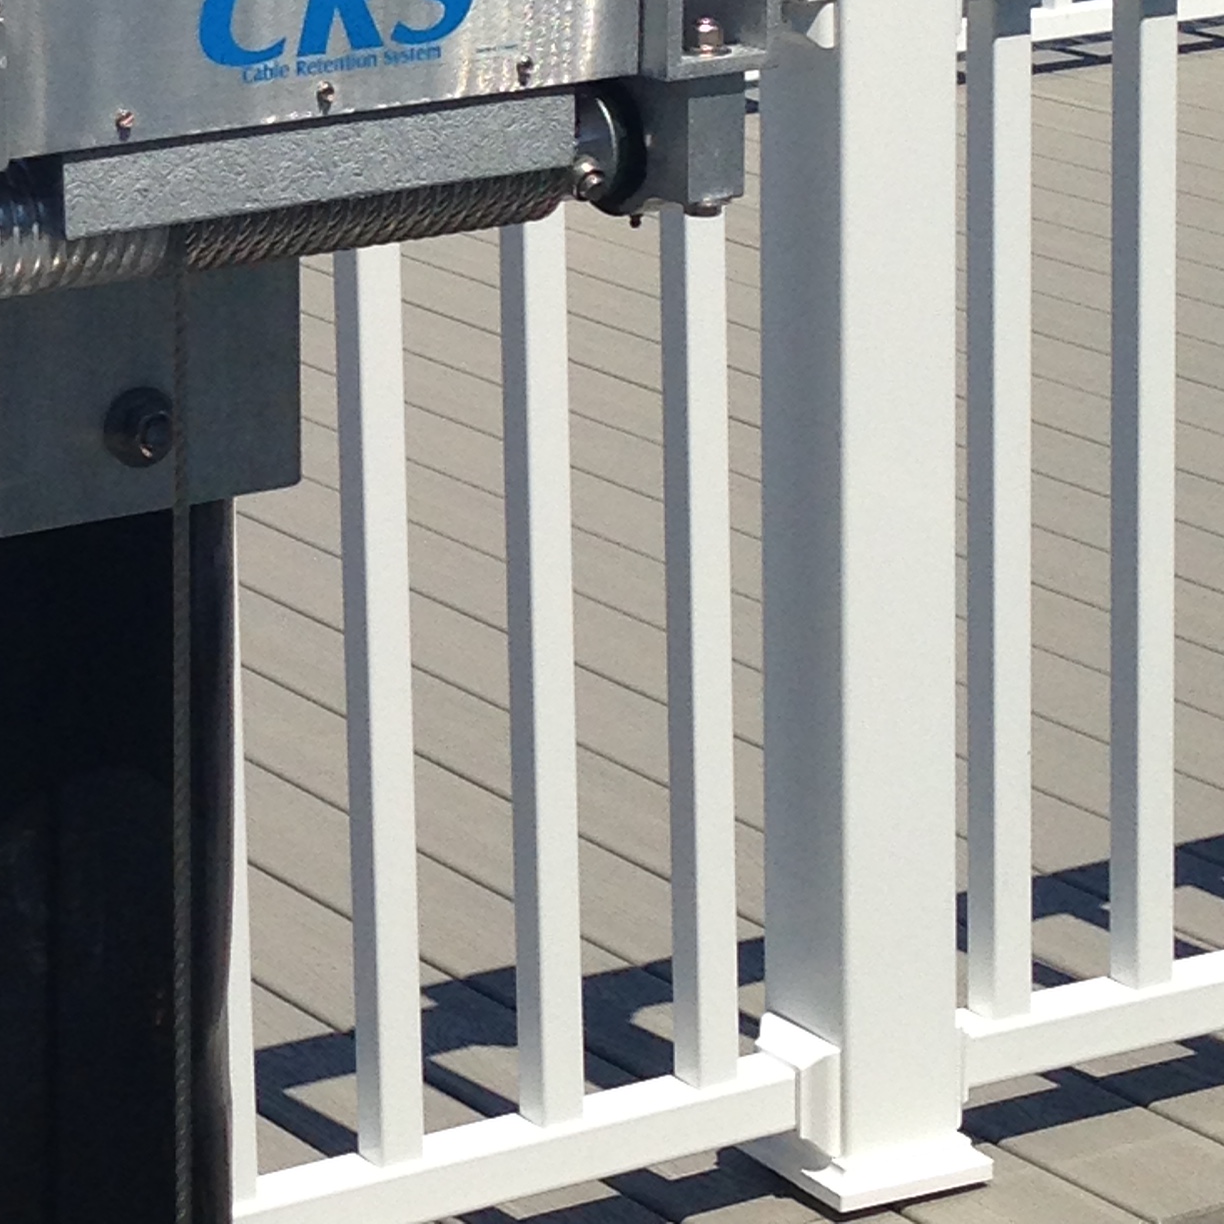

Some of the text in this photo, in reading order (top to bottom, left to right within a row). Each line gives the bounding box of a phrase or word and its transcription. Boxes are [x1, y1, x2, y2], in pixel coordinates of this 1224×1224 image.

[242, 45, 443, 83] Cable Retention System
